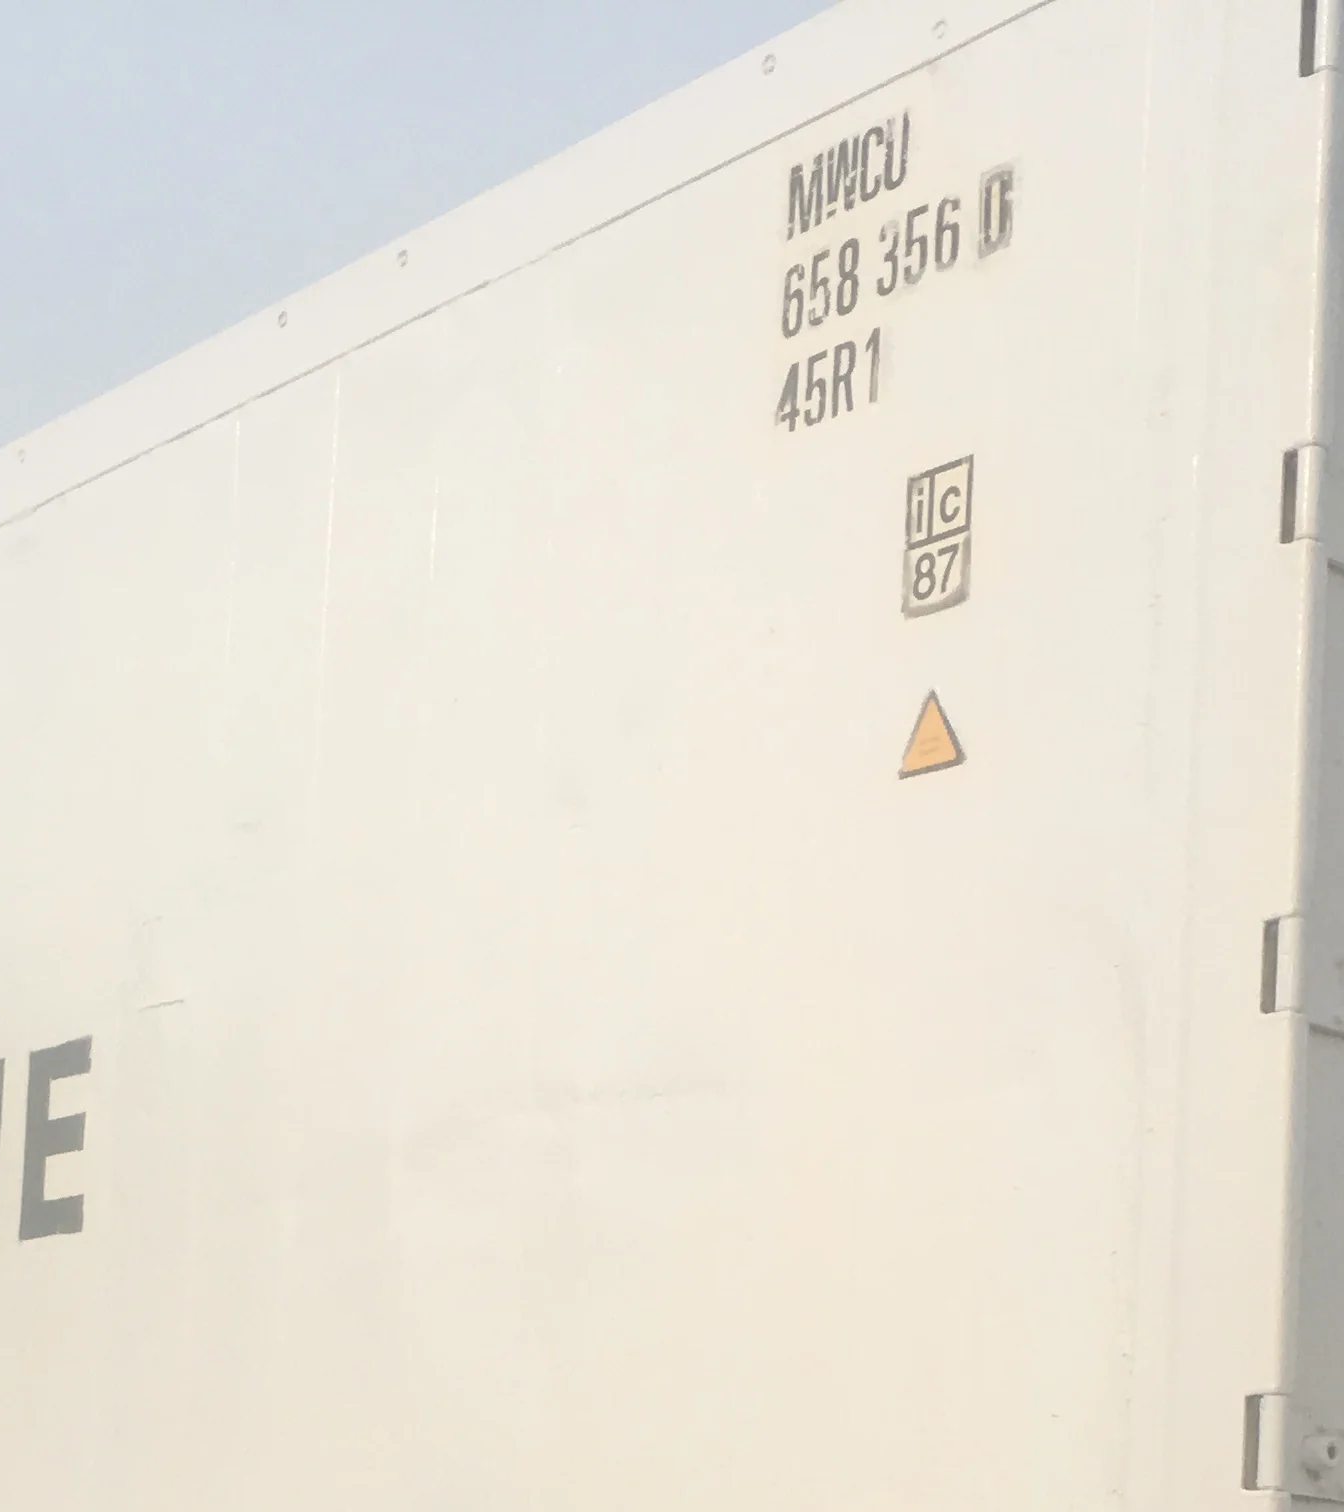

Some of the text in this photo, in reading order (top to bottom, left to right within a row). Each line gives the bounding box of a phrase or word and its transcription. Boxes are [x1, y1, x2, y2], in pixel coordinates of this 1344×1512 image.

[786, 109, 911, 242] MWCU
[782, 237, 860, 340] 658
[876, 195, 962, 298] 356
[775, 327, 882, 433] 45R1
[912, 542, 960, 601] 87
